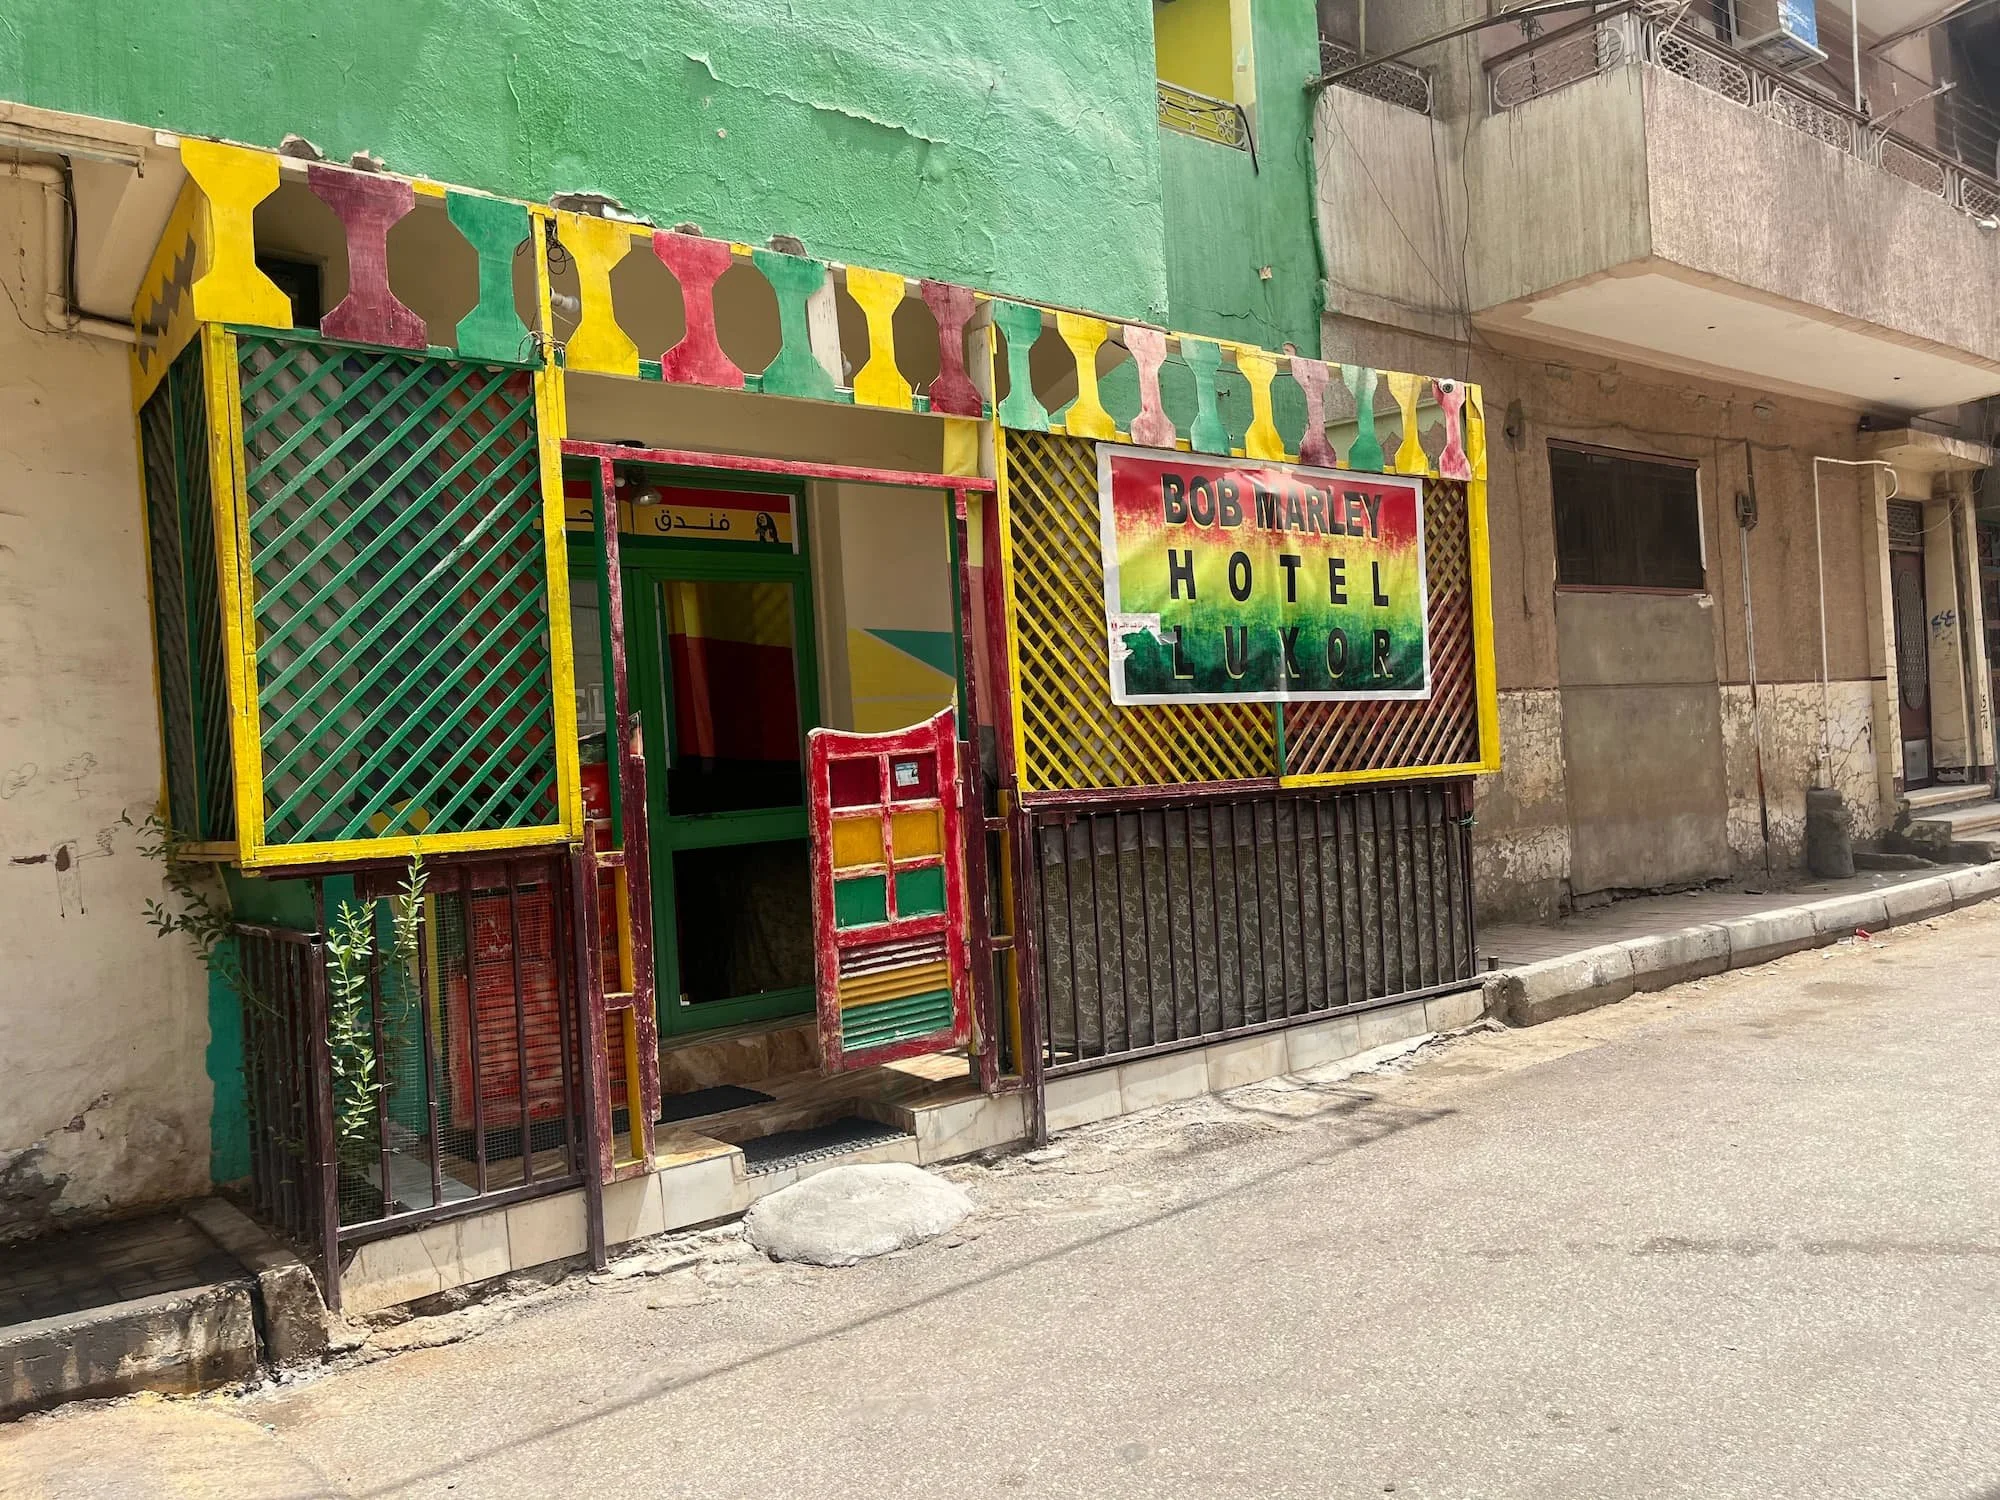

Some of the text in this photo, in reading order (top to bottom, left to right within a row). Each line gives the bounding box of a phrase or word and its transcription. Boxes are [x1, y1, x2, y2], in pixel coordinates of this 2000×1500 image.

[654, 509, 730, 531] فندق
[1161, 473, 1382, 542] BOB MARLEY
[1167, 549, 1389, 607] HOTEL
[1173, 625, 1393, 680] LUXOR
